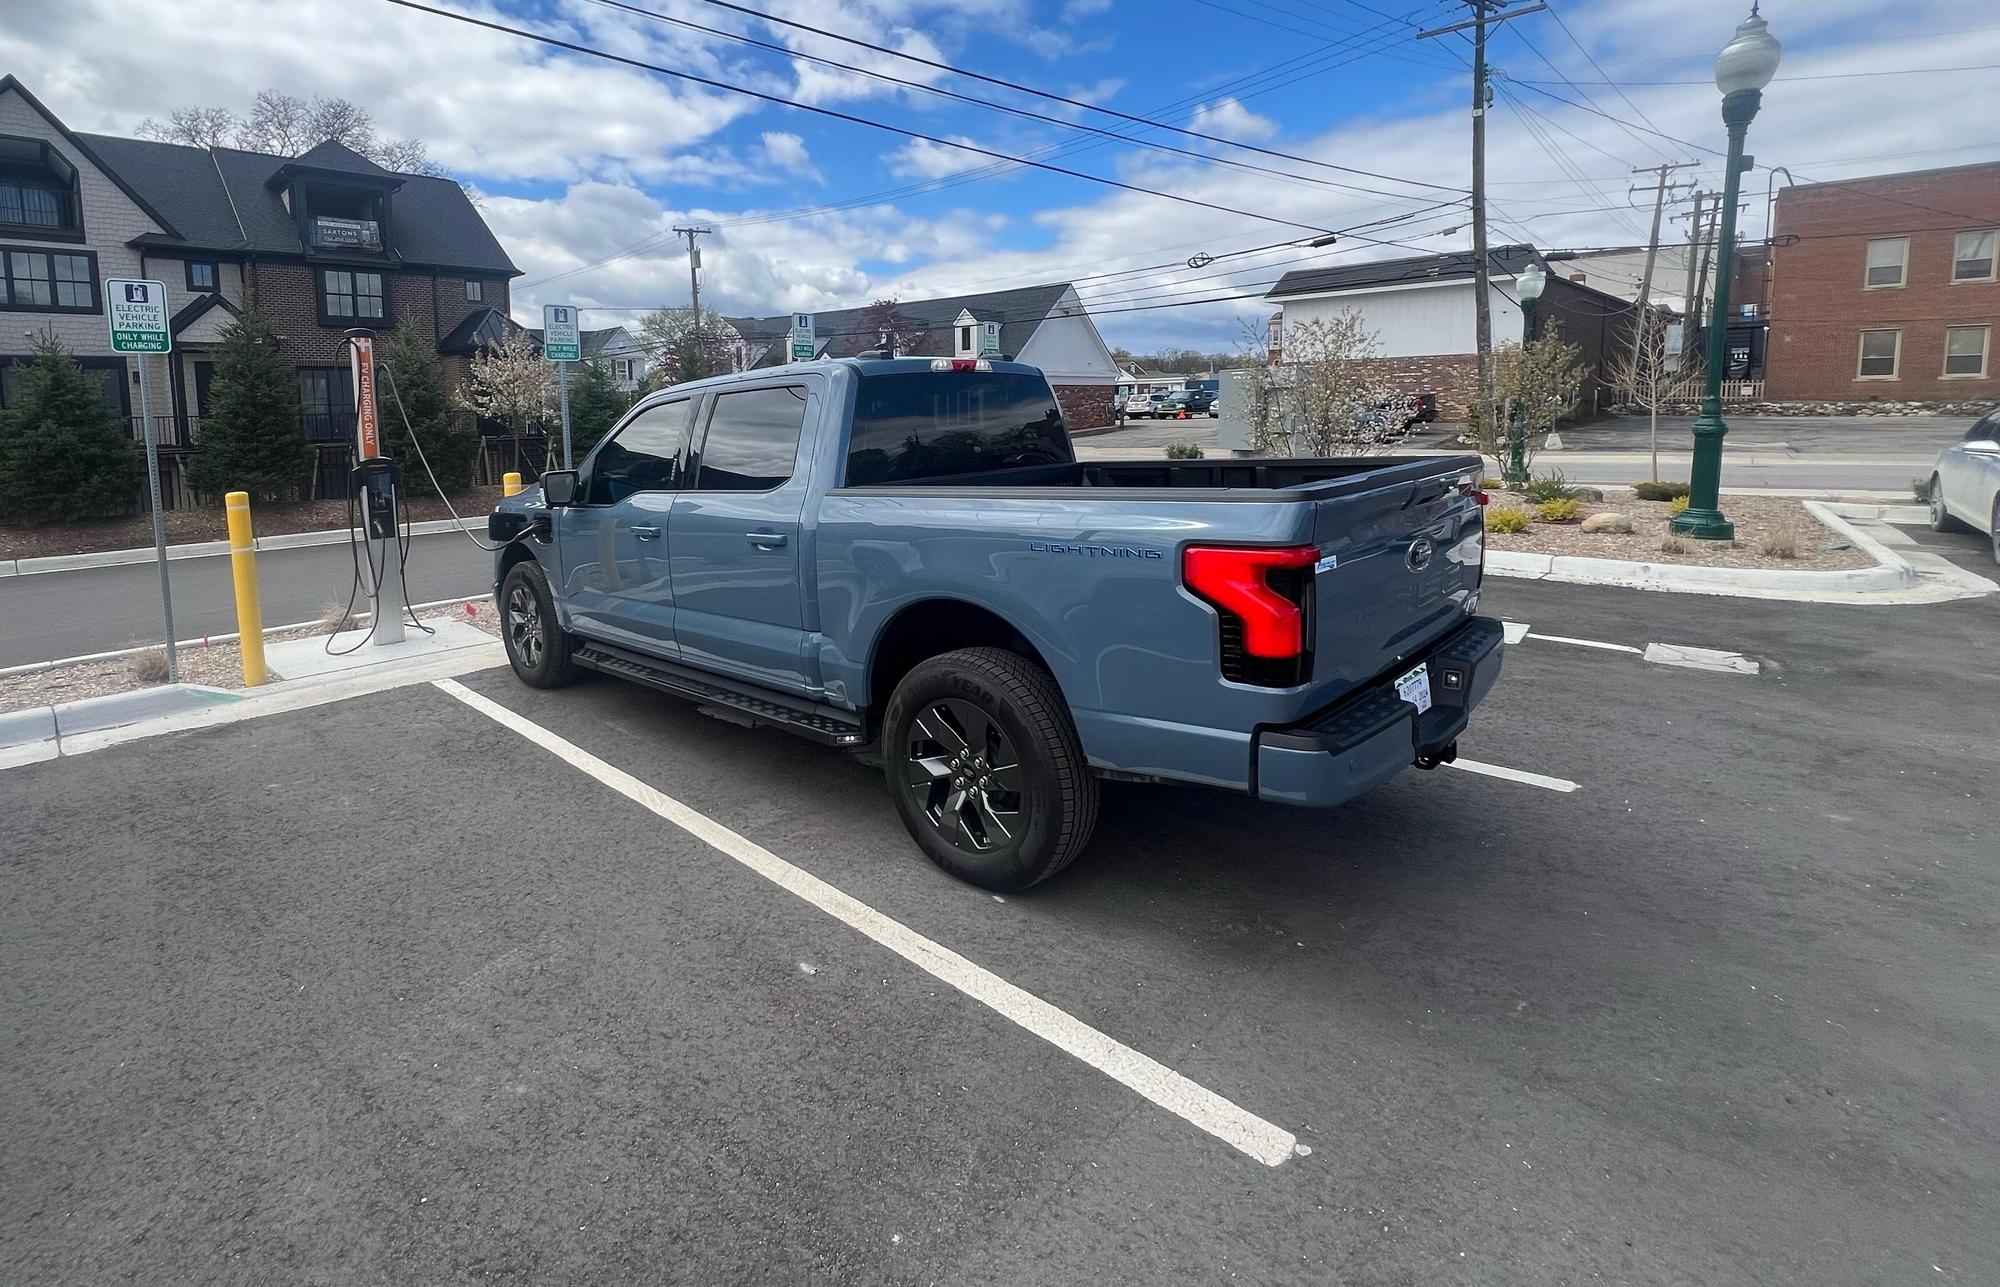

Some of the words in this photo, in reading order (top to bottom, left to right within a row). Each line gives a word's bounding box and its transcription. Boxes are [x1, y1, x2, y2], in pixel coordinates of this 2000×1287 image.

[322, 228, 358, 236] SAXTONS
[115, 304, 160, 313] ELECTRIC
[119, 313, 159, 321] VEHICLE
[118, 322, 161, 330] PARKING
[140, 333, 165, 342] WHILE
[121, 341, 162, 350] CHARGING
[361, 375, 372, 421] CHARGING
[364, 424, 375, 445] ONLY
[1030, 542, 1164, 560] LIGHTNING
